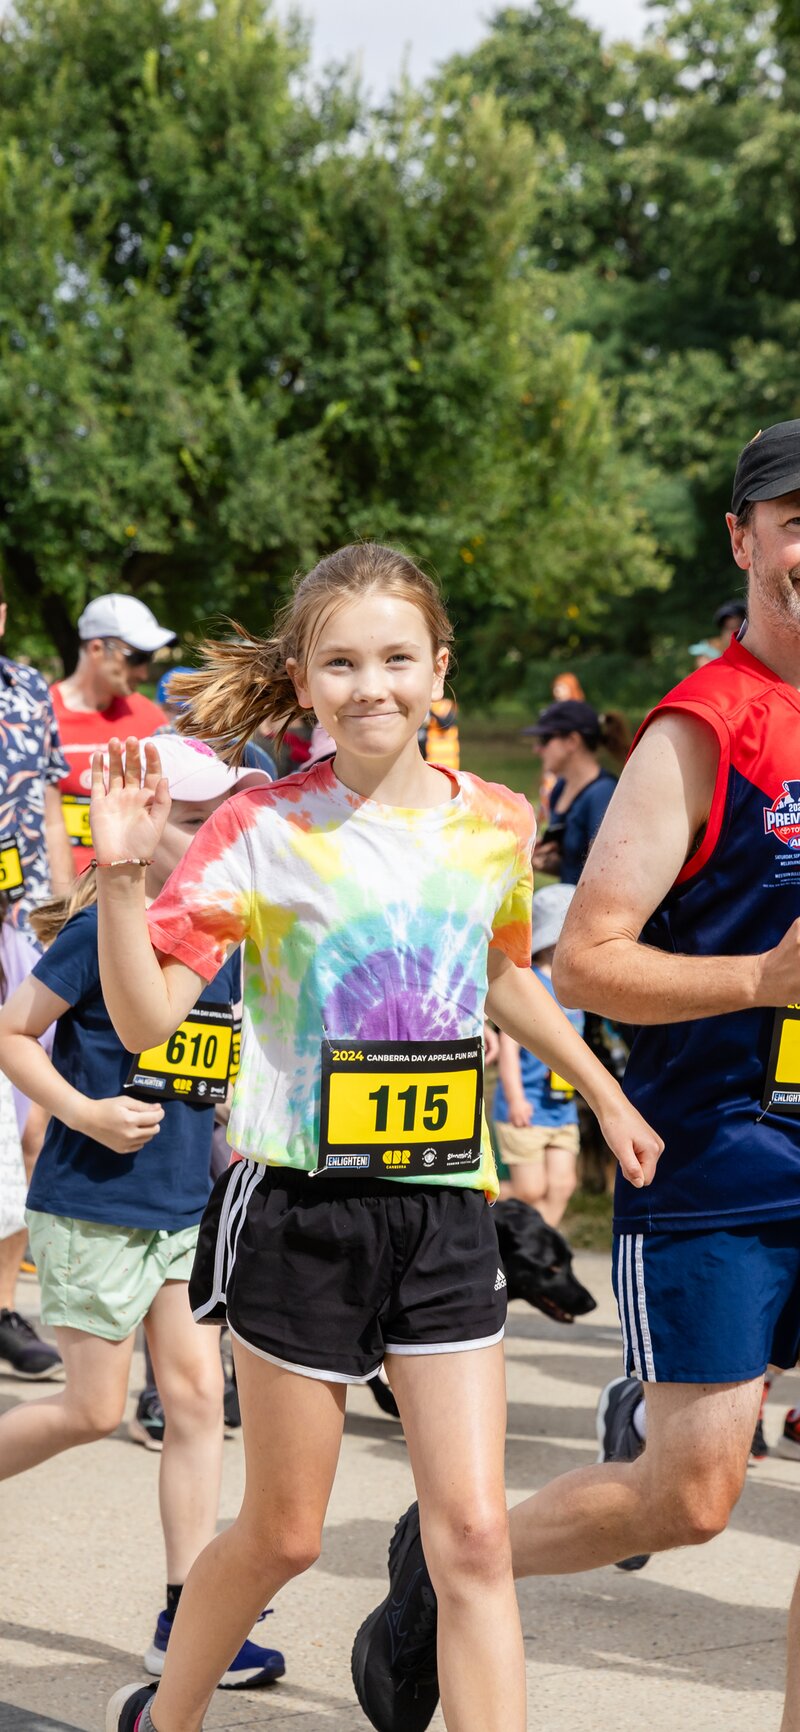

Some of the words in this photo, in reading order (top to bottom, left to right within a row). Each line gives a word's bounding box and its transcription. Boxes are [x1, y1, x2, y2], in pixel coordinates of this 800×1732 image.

[166, 1031, 217, 1068] 610
[332, 1050, 365, 1062] 2024
[366, 1054, 410, 1062] CANBERRA
[411, 1054, 428, 1062] DAY
[427, 1053, 455, 1062] APPEAL
[454, 1052, 467, 1061] FUN
[467, 1050, 478, 1059] RUN
[369, 1085, 449, 1132] 115
